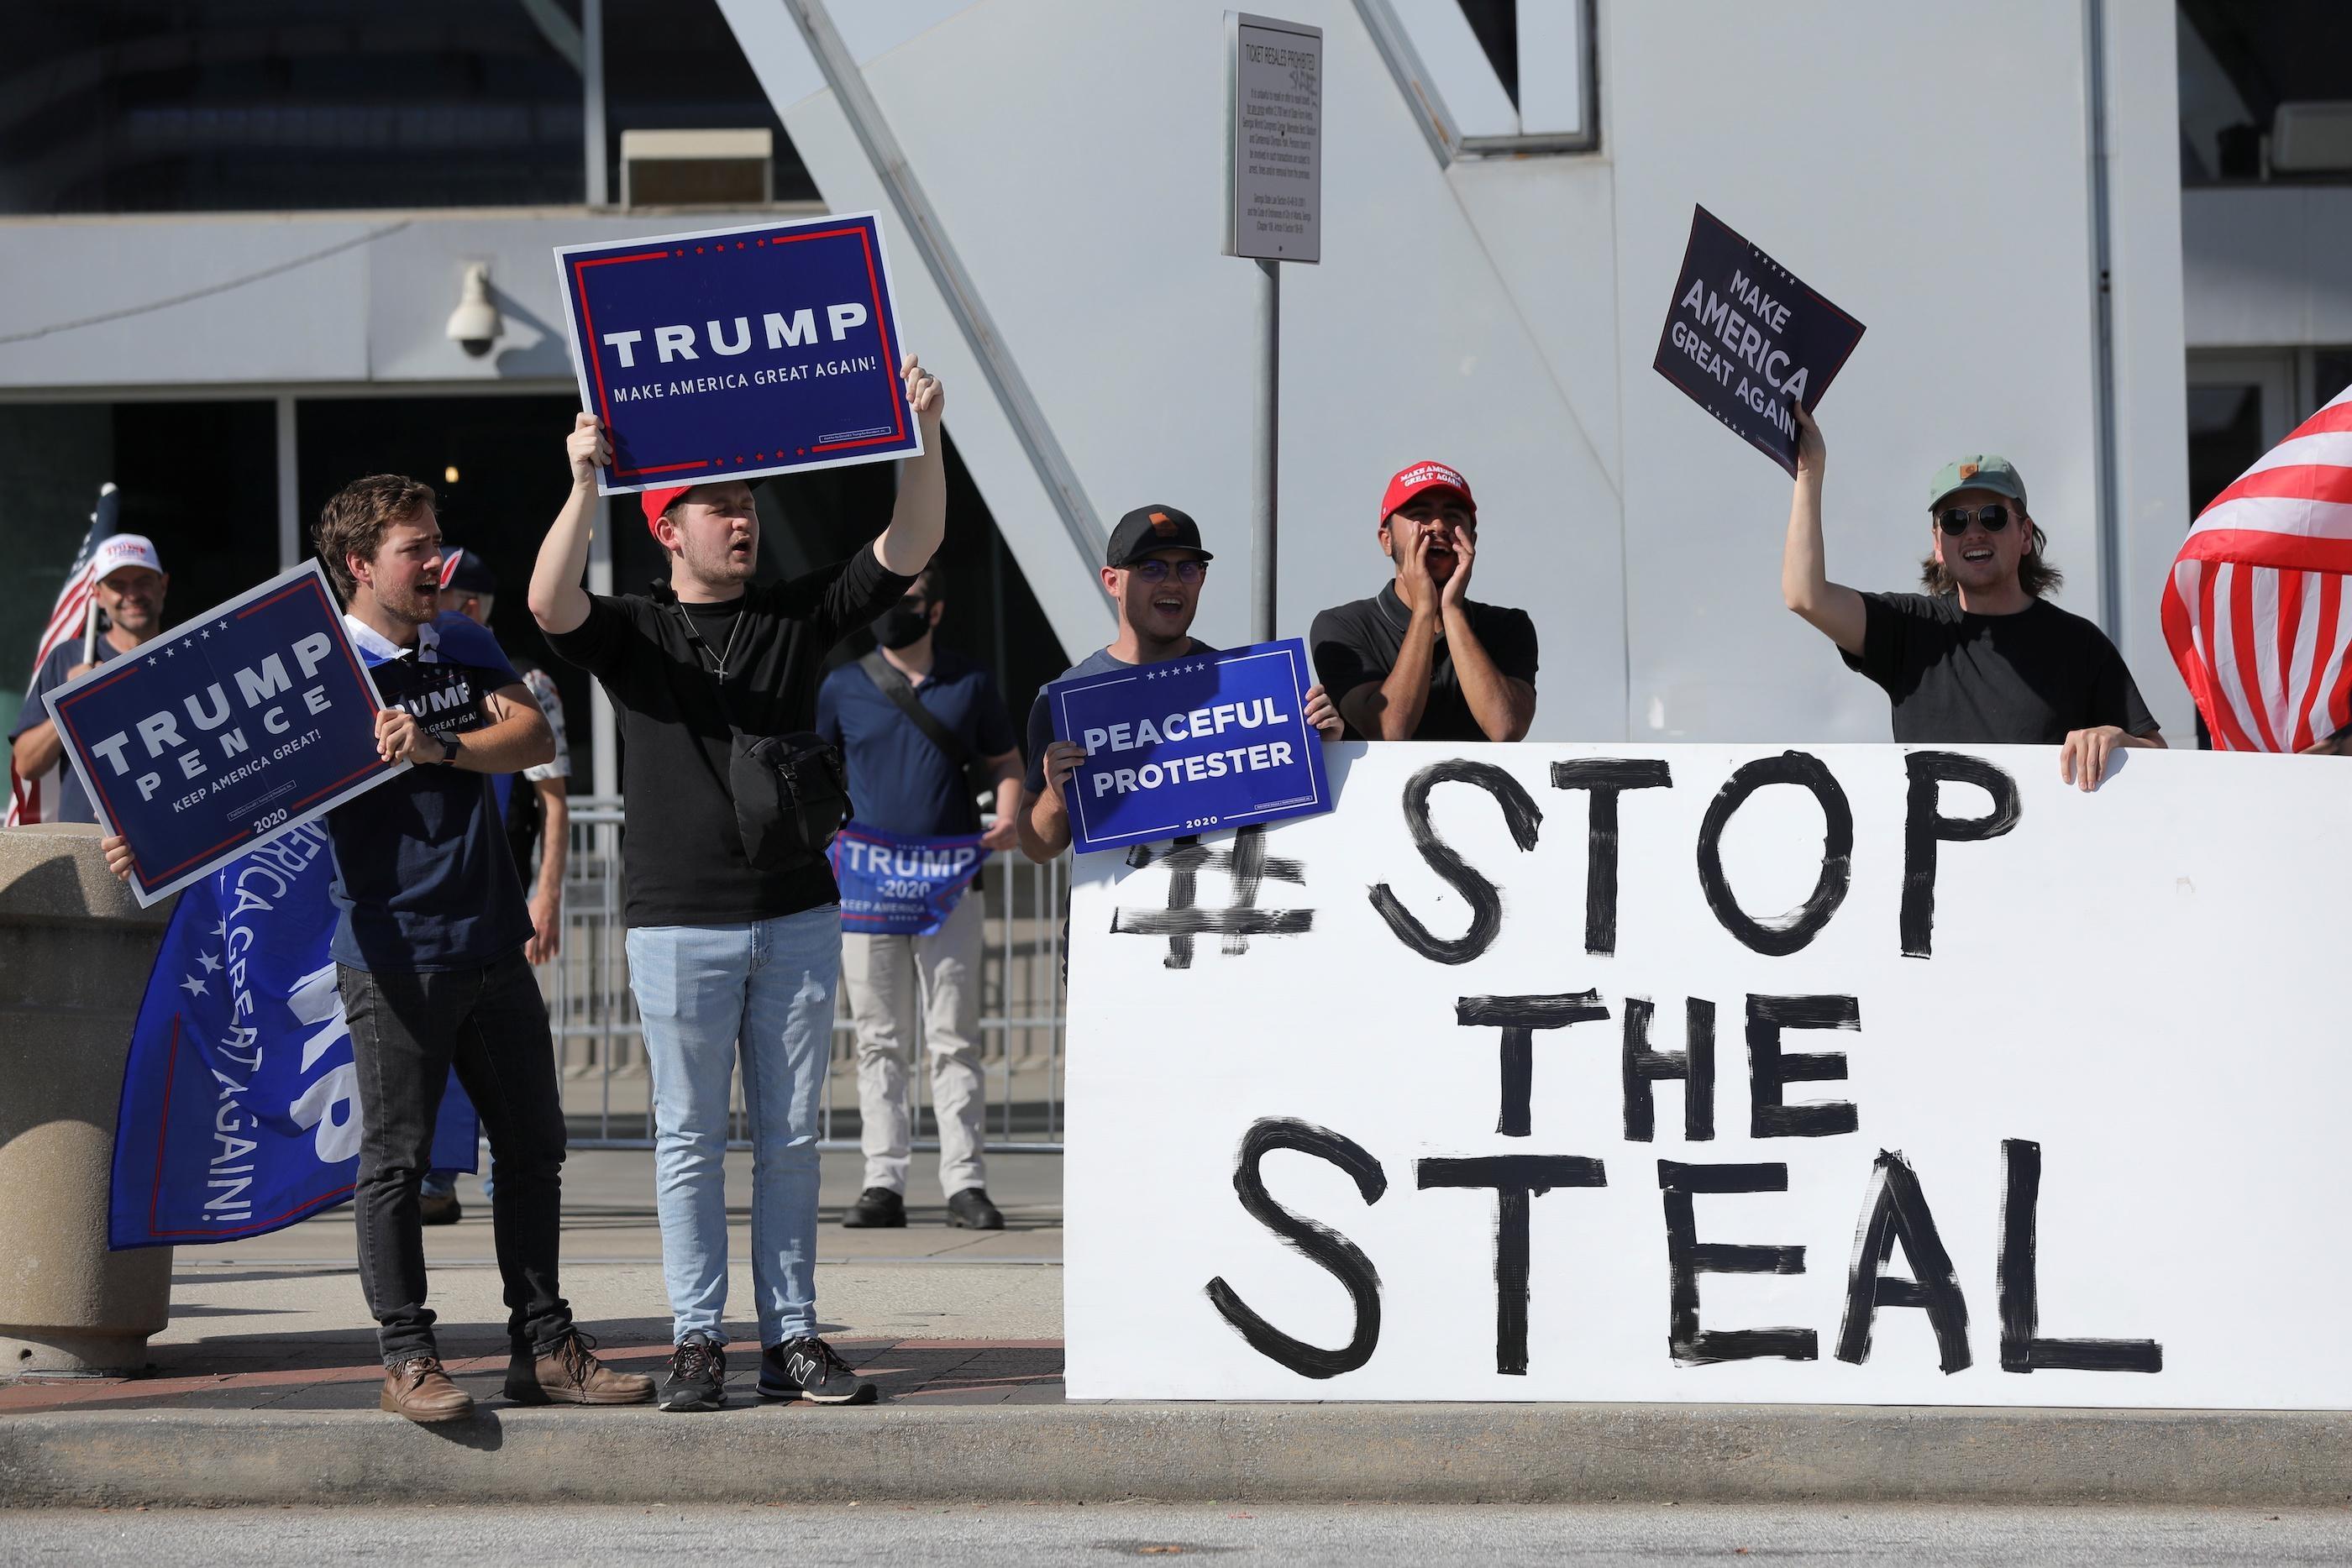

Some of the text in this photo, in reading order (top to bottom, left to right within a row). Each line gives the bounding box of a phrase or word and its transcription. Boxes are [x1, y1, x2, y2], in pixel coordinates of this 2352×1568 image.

[1729, 269, 1792, 334] MAKE
[603, 302, 868, 368] TRUMP
[1681, 278, 1809, 401] AMERICA
[614, 355, 877, 402] MAKE AMERICA GREAT AGAIN!
[1672, 321, 1797, 442] GREAT AGAIN
[1399, 466, 1425, 483] MAKE
[1404, 473, 1462, 488] GREAT AGAIN
[91, 632, 333, 777] TRUMP
[386, 682, 470, 717] UMP
[1084, 697, 1289, 757] PEACEFUL
[136, 684, 332, 801] PENCE
[172, 787, 207, 813] KEEP
[210, 755, 271, 795] AMERICA
[274, 729, 323, 763] GREAT!
[1093, 741, 1294, 798] PROTESTER
[253, 808, 288, 834] 2020
[1185, 815, 1219, 829] 2020
[844, 841, 976, 878] TRUMP
[841, 899, 872, 912] KEEP
[1455, 989, 1862, 1141] THE
[201, 1067, 258, 1222] AGAIN!
[1205, 1117, 2164, 1379] STEAL
